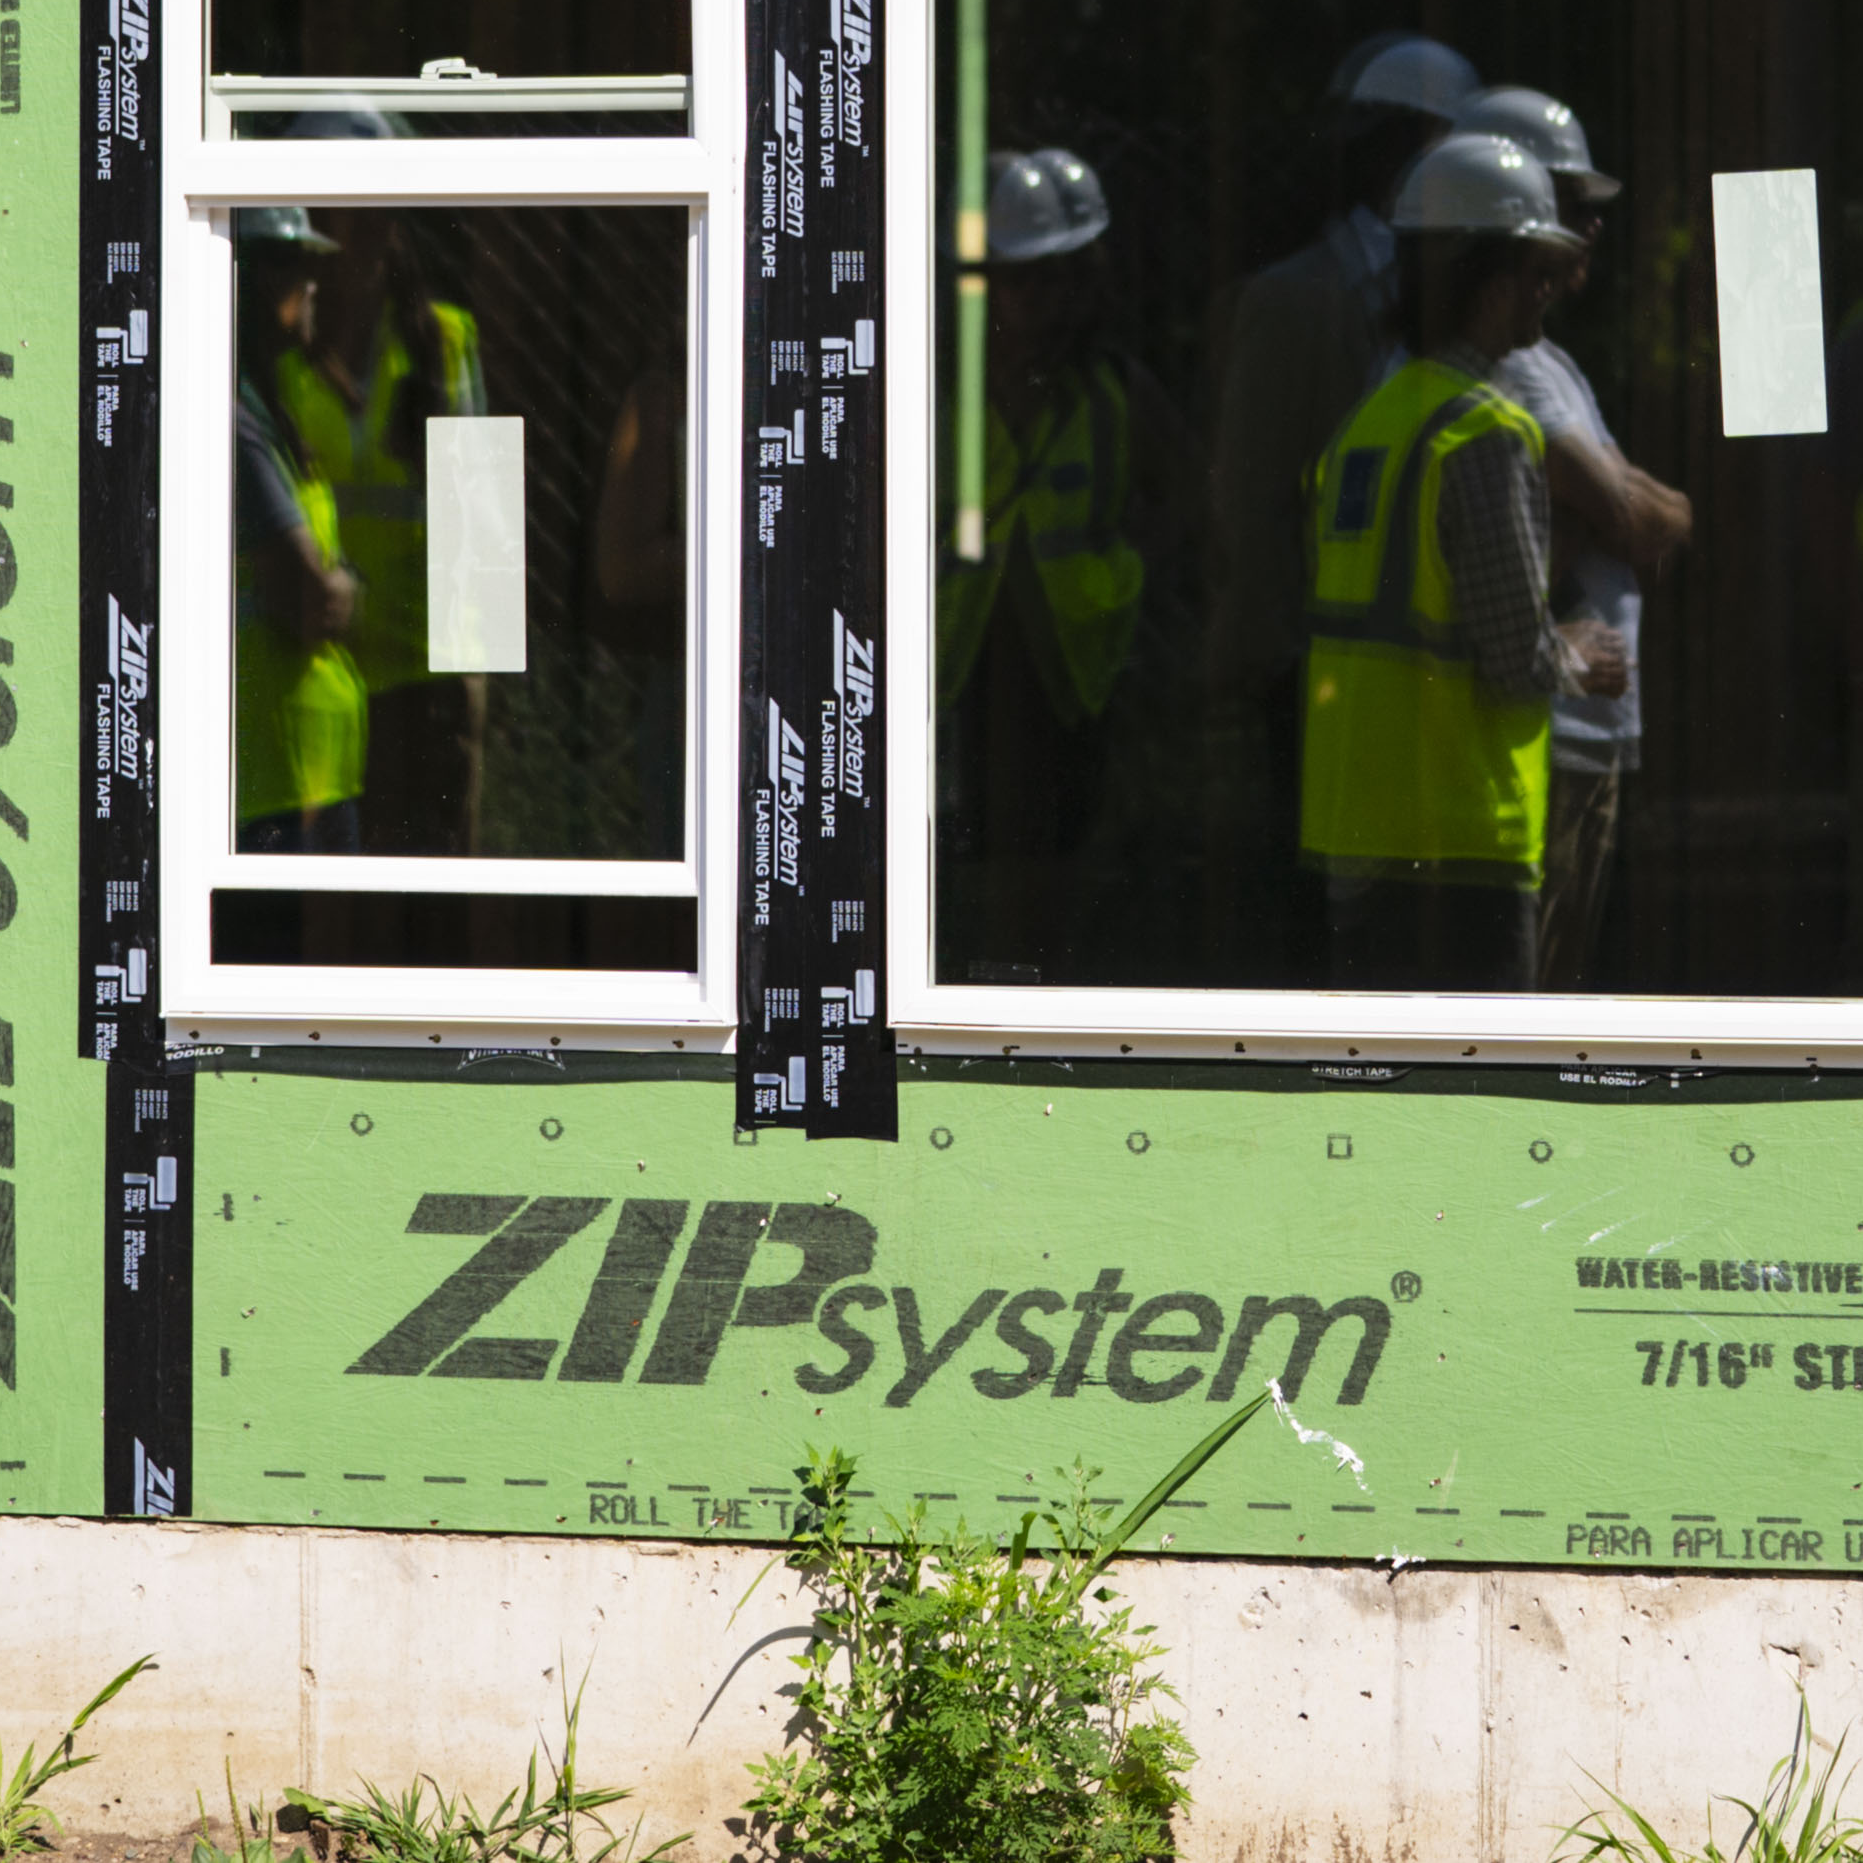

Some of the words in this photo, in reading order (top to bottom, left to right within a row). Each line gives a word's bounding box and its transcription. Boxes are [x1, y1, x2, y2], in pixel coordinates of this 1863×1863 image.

[98, 46, 111, 131] FLASHING
[98, 136, 111, 180] TAPE
[822, 701, 835, 788] FLASHING
[821, 793, 835, 837] TAPE
[1575, 1257, 1863, 1295] WATER-RESISTIVE
[589, 1494, 669, 1528] ROLL
[692, 1497, 752, 1530] THE
[1564, 1524, 1652, 1557] PARA
[1672, 1527, 1823, 1562] APLICAR
